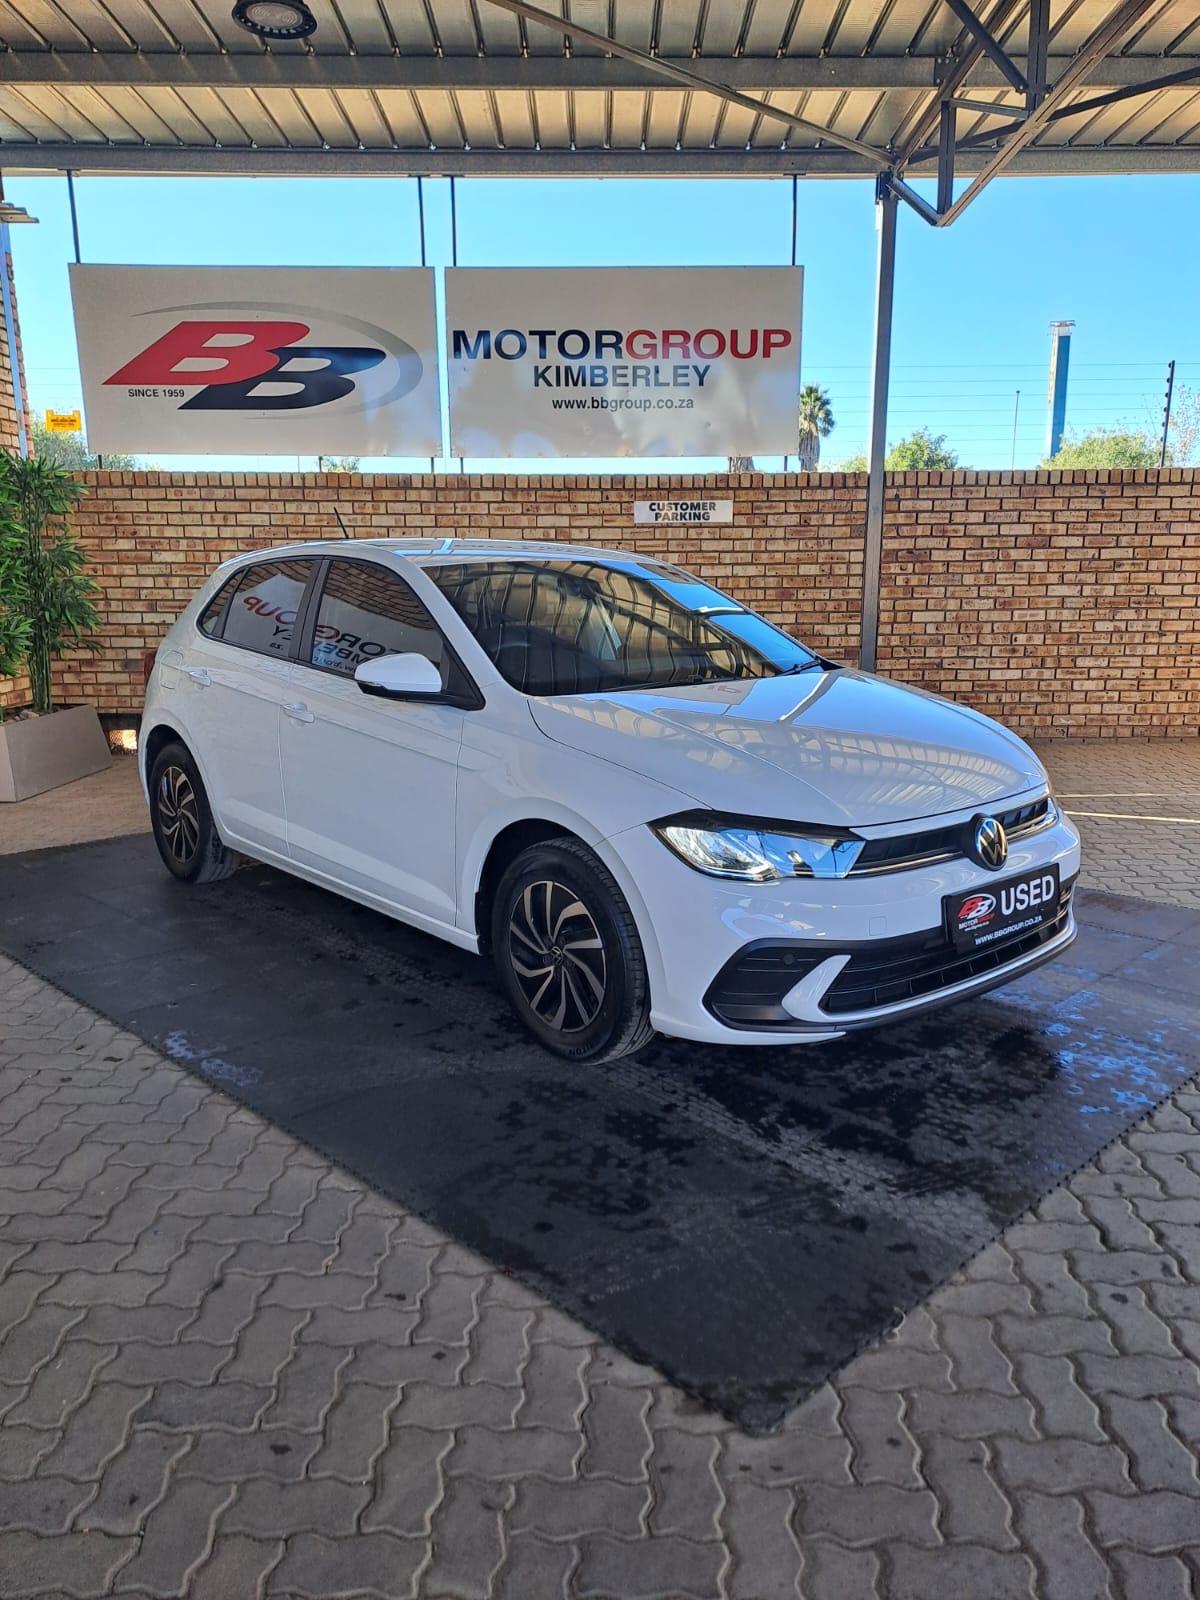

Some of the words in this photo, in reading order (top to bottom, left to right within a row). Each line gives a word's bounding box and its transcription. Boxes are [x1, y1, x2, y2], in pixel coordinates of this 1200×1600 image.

[452, 328, 793, 360] MOTORGROUP
[533, 364, 712, 388] KIMBERLEY
[128, 388, 159, 398] SINCE
[162, 388, 185, 398] 1959
[551, 396, 695, 413] www.bbgroup.co.za
[648, 501, 716, 512] CUSTOMER
[654, 511, 710, 521] PARKING
[1000, 874, 1055, 916] USED
